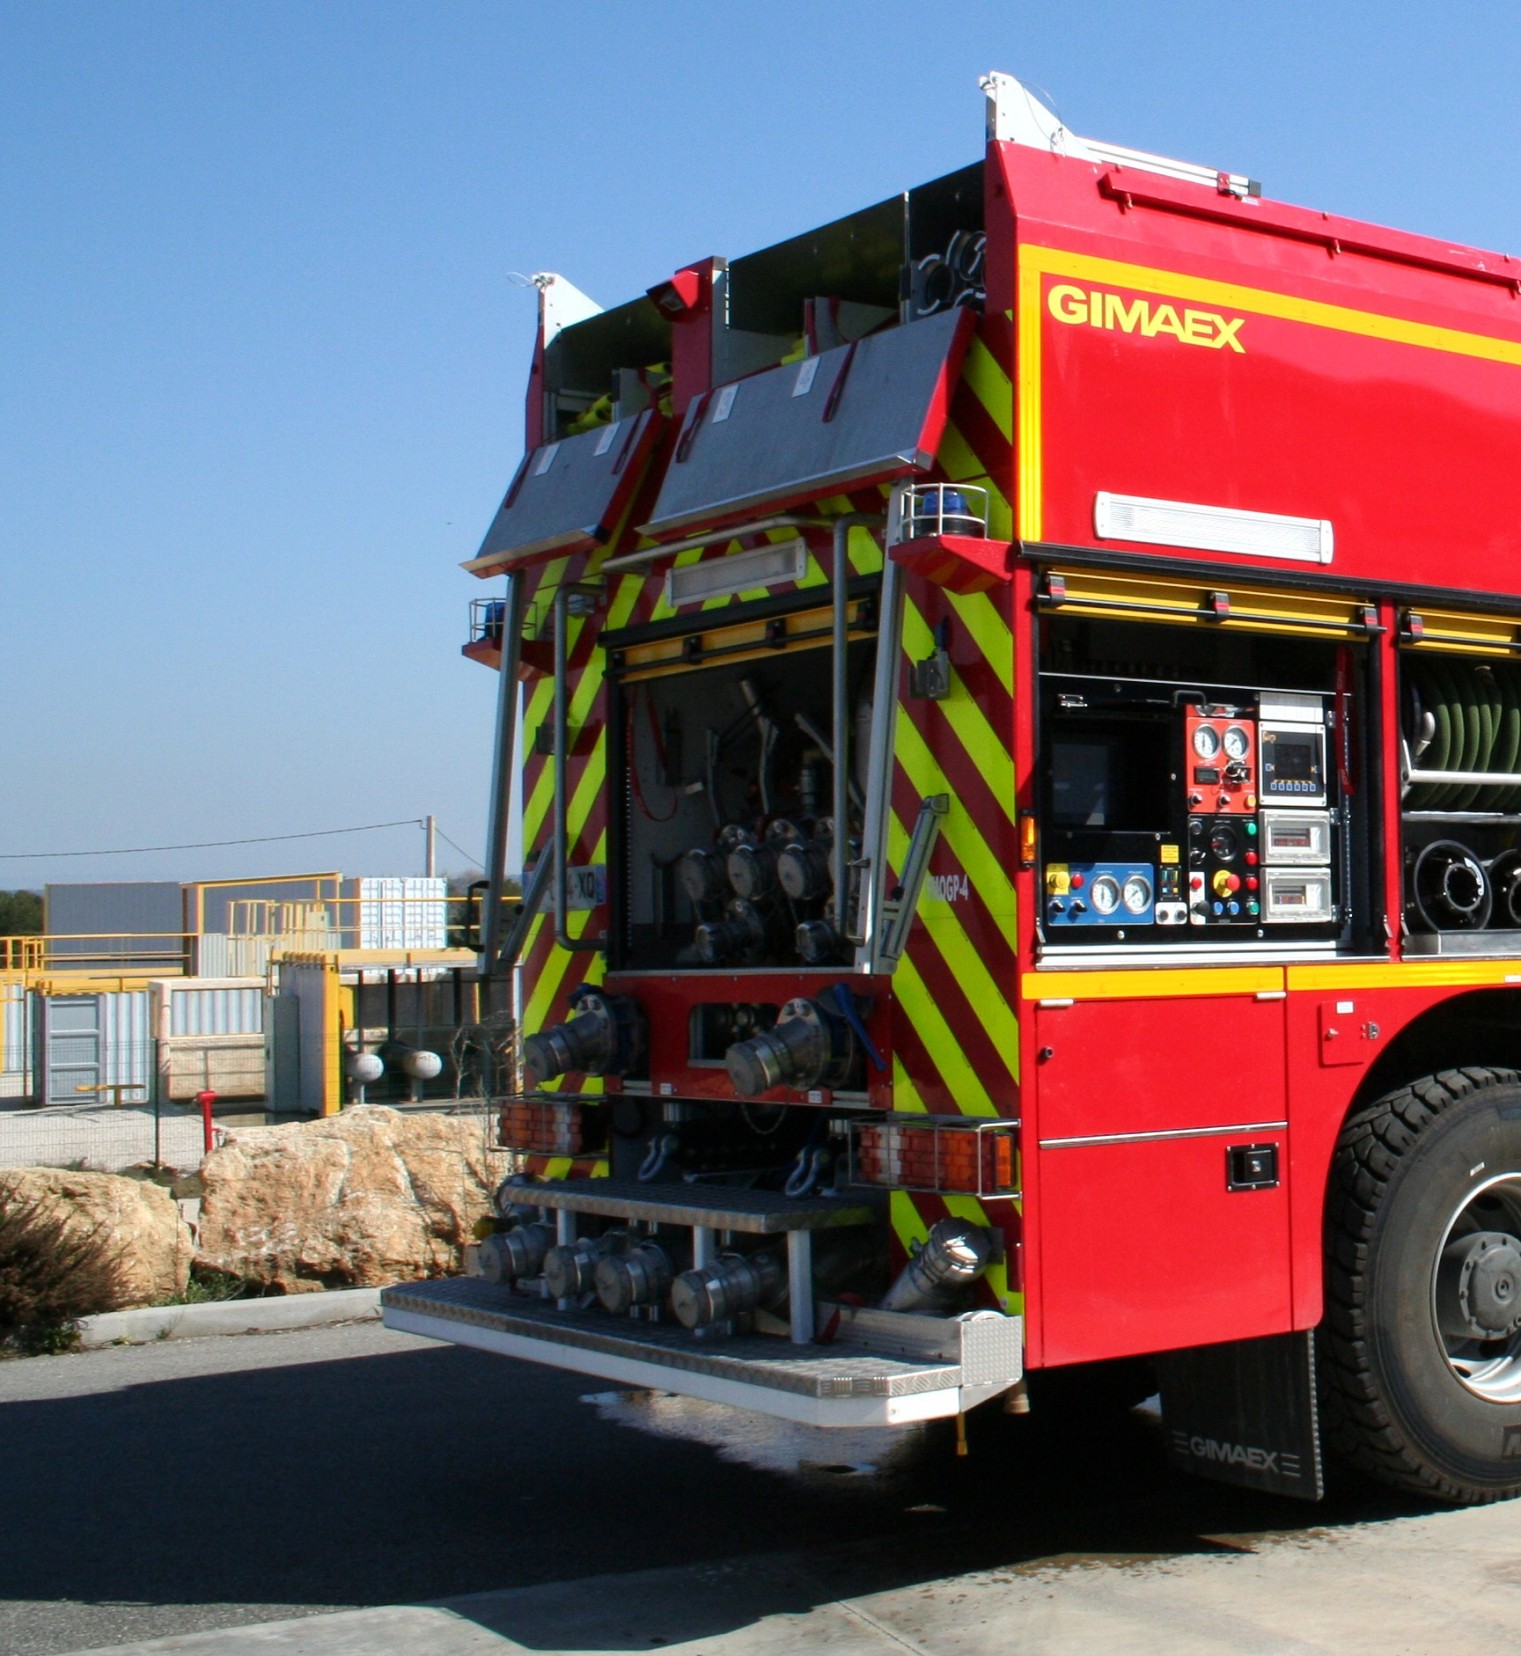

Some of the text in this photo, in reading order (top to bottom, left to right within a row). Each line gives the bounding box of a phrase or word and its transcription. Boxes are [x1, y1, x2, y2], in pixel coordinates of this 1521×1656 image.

[1048, 285, 1246, 353] GIMAEX
[926, 874, 969, 902] MOGP-4
[1190, 1436, 1279, 1472] GIMAEX
